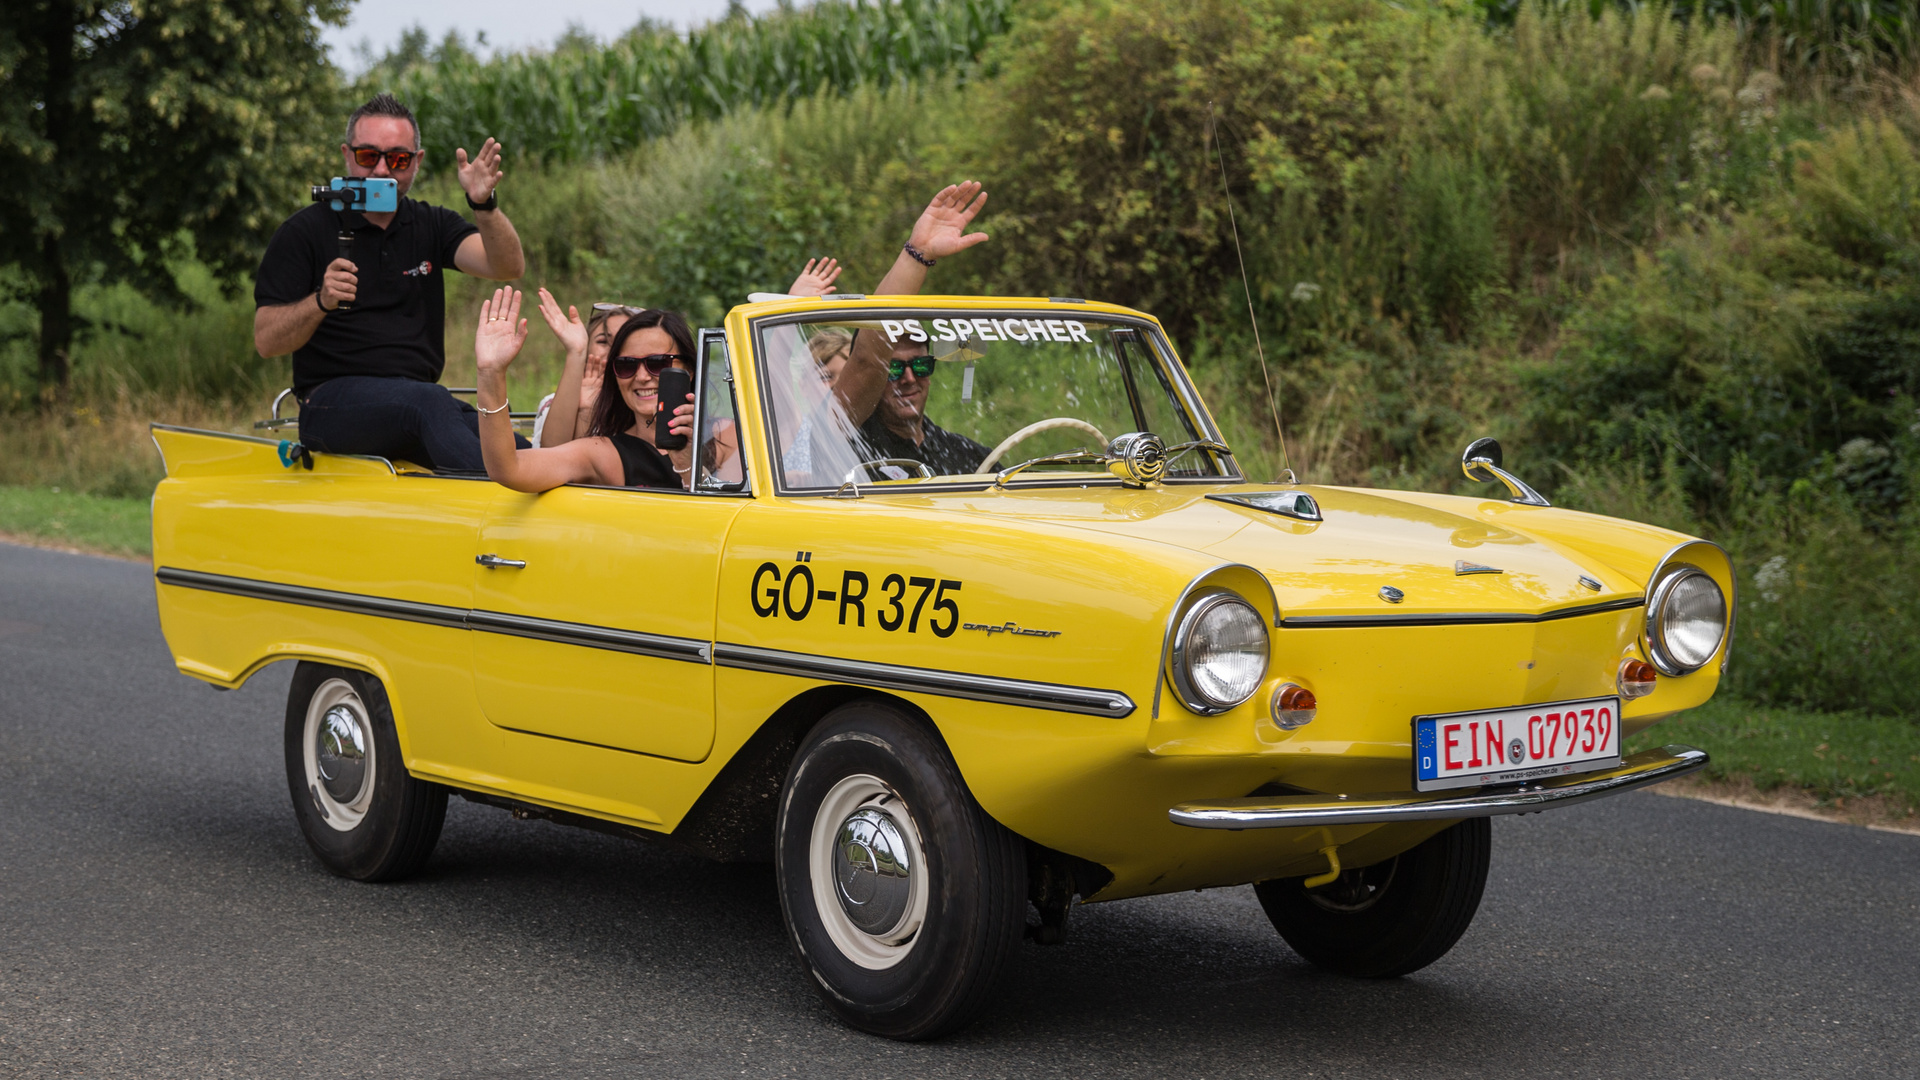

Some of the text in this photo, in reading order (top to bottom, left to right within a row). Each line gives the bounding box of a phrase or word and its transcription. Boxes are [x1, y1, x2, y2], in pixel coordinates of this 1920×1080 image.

[880, 318, 1093, 343] PS.SPEICHER
[751, 551, 963, 638] GÖ-R 375
[1443, 707, 1612, 771] EIN 07939
[1423, 756, 1432, 770] D
[1499, 766, 1559, 780] www.ps-speicher.de
